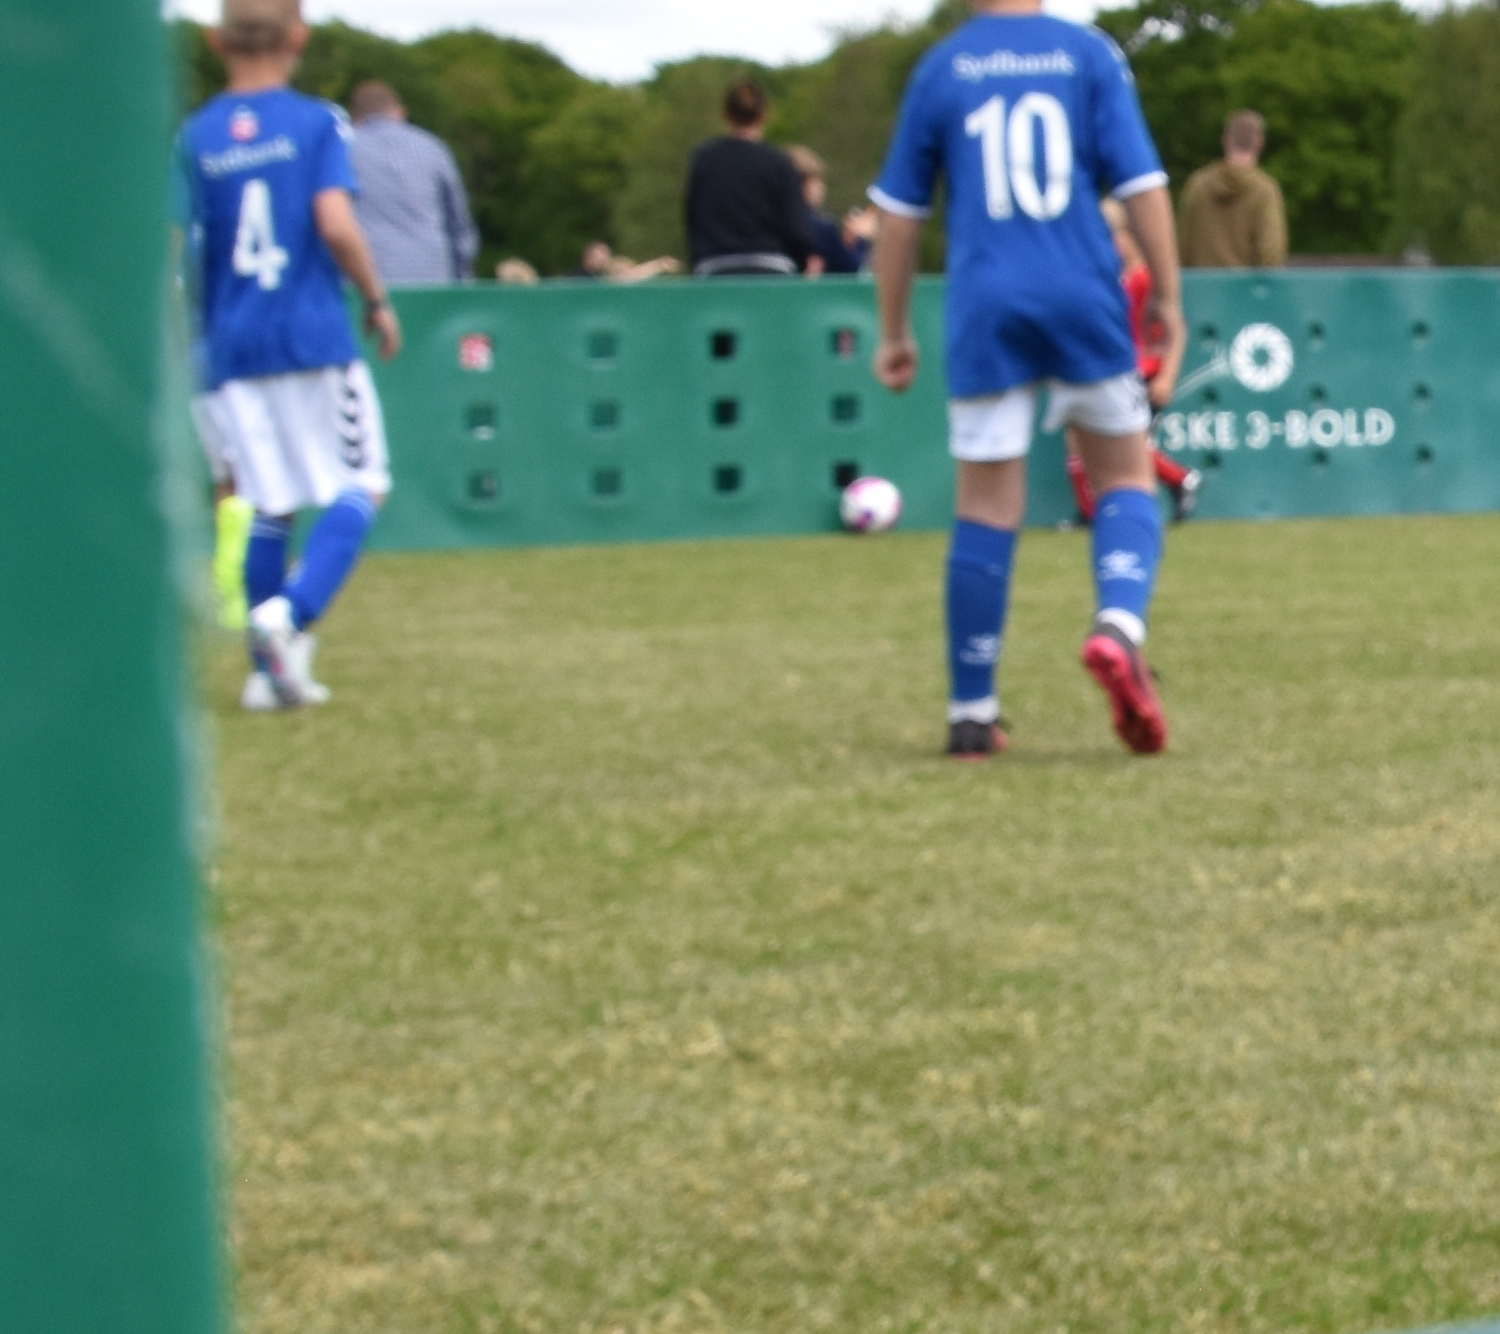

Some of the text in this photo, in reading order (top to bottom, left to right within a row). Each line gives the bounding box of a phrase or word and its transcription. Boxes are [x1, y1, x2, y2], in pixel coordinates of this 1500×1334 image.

[965, 92, 1072, 220] 10
[233, 179, 288, 290] 4
[1152, 408, 1396, 451] SKE 3-BOLD
